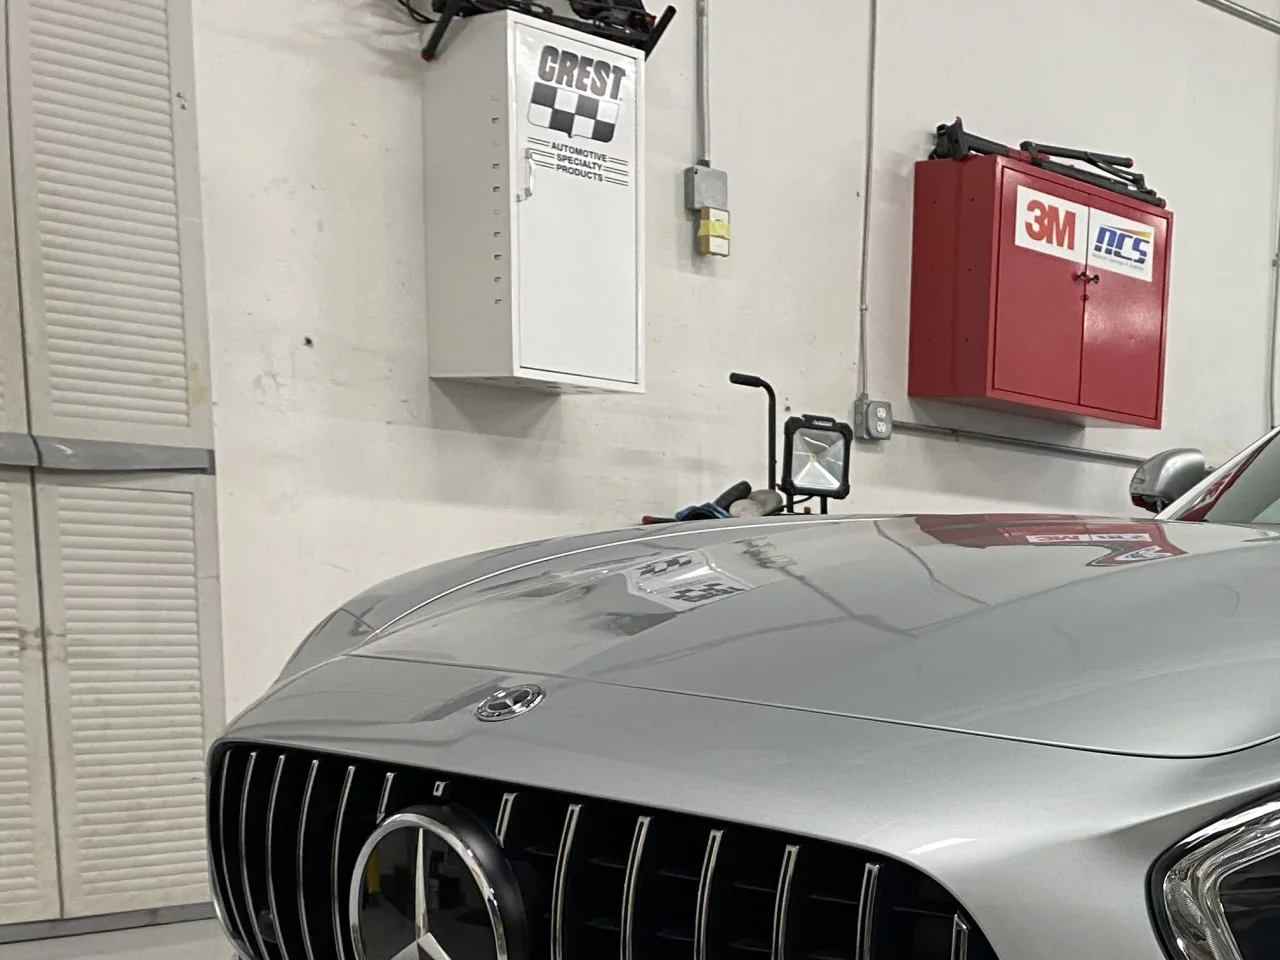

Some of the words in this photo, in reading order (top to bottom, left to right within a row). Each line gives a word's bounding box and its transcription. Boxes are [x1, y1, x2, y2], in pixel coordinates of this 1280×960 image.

[538, 45, 626, 100] CREST
[551, 142, 608, 163] AUTOMOTIVE
[556, 153, 603, 171] SPECIALTY
[556, 163, 603, 182] PRODUCTS
[1025, 200, 1076, 250] 3M
